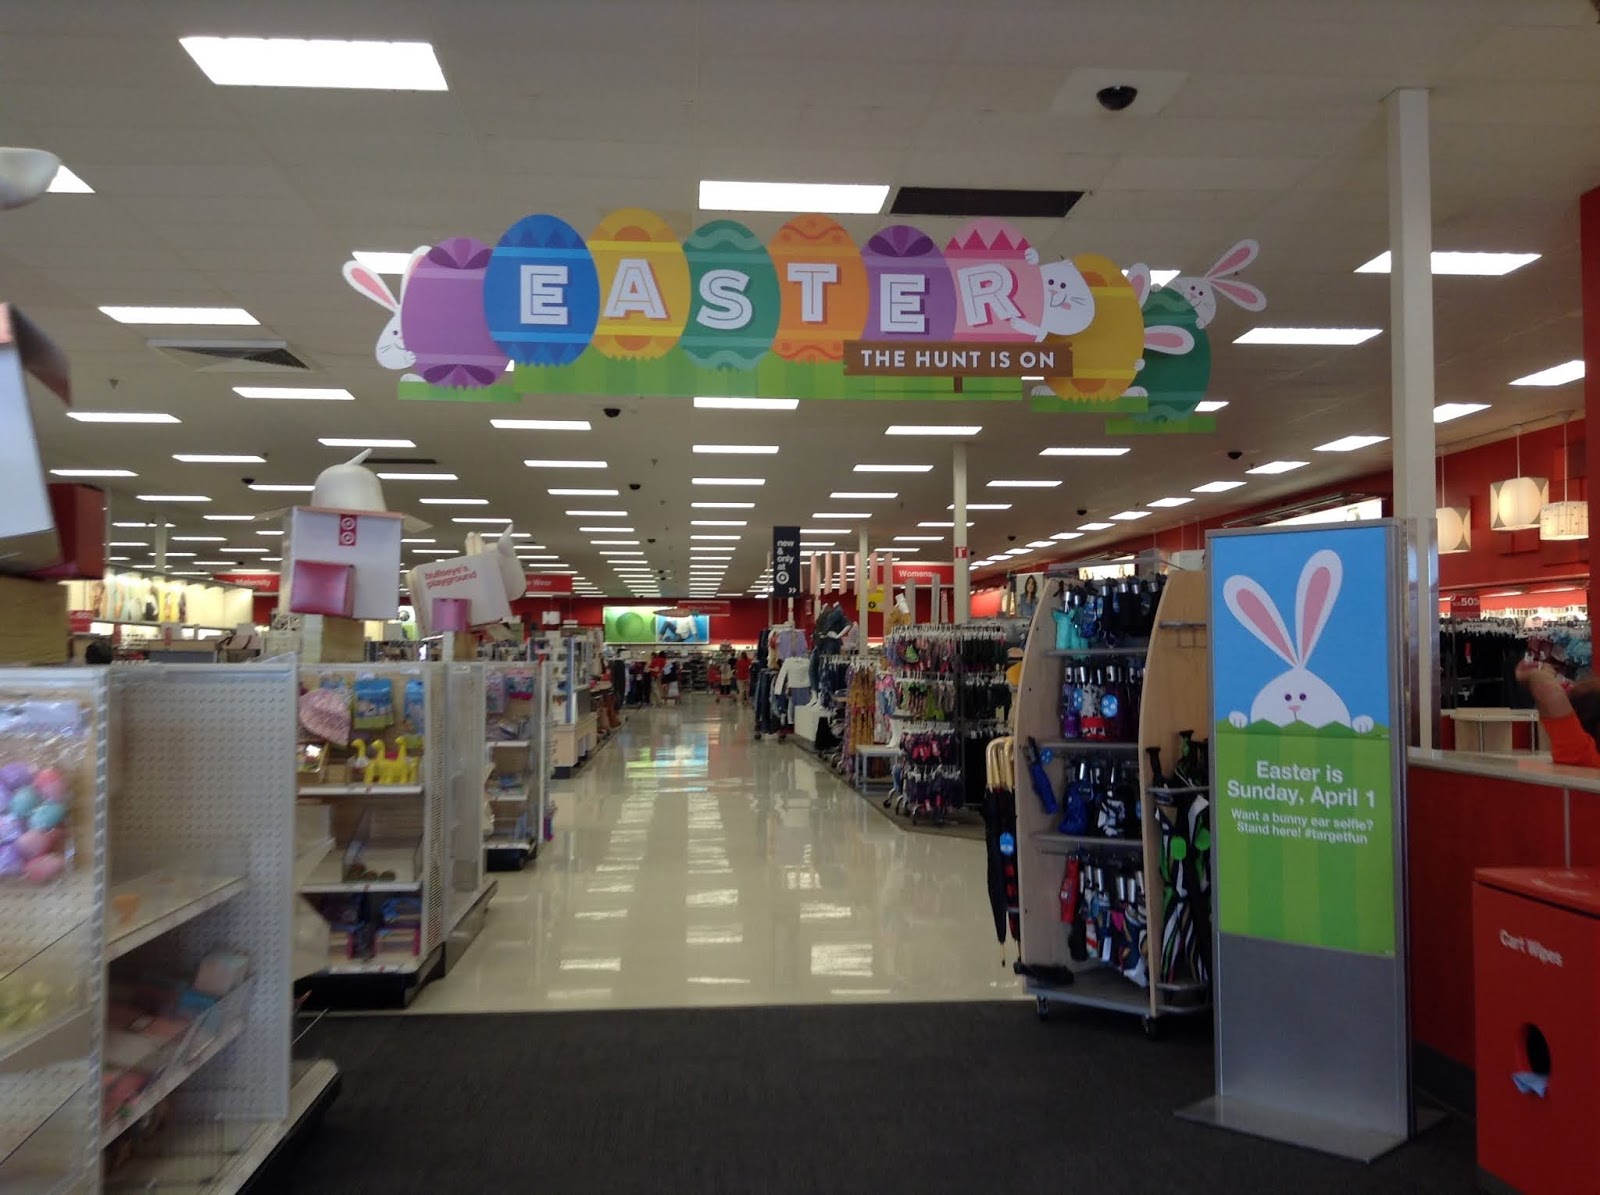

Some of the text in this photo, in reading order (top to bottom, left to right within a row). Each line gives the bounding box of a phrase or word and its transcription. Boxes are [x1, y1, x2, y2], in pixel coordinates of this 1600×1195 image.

[519, 257, 1028, 334] EASTER
[861, 349, 1055, 369] THE HUNT IS ON
[777, 554, 795, 564] only
[899, 569, 932, 578] Womens
[1256, 760, 1344, 784] Easter is
[1227, 778, 1376, 808] Sunday, April 1
[1231, 807, 1374, 832] Want a bunny ear selfie?
[1237, 821, 1368, 845] Stand here! #targetfun
[1500, 928, 1563, 968] Cart Wipes
